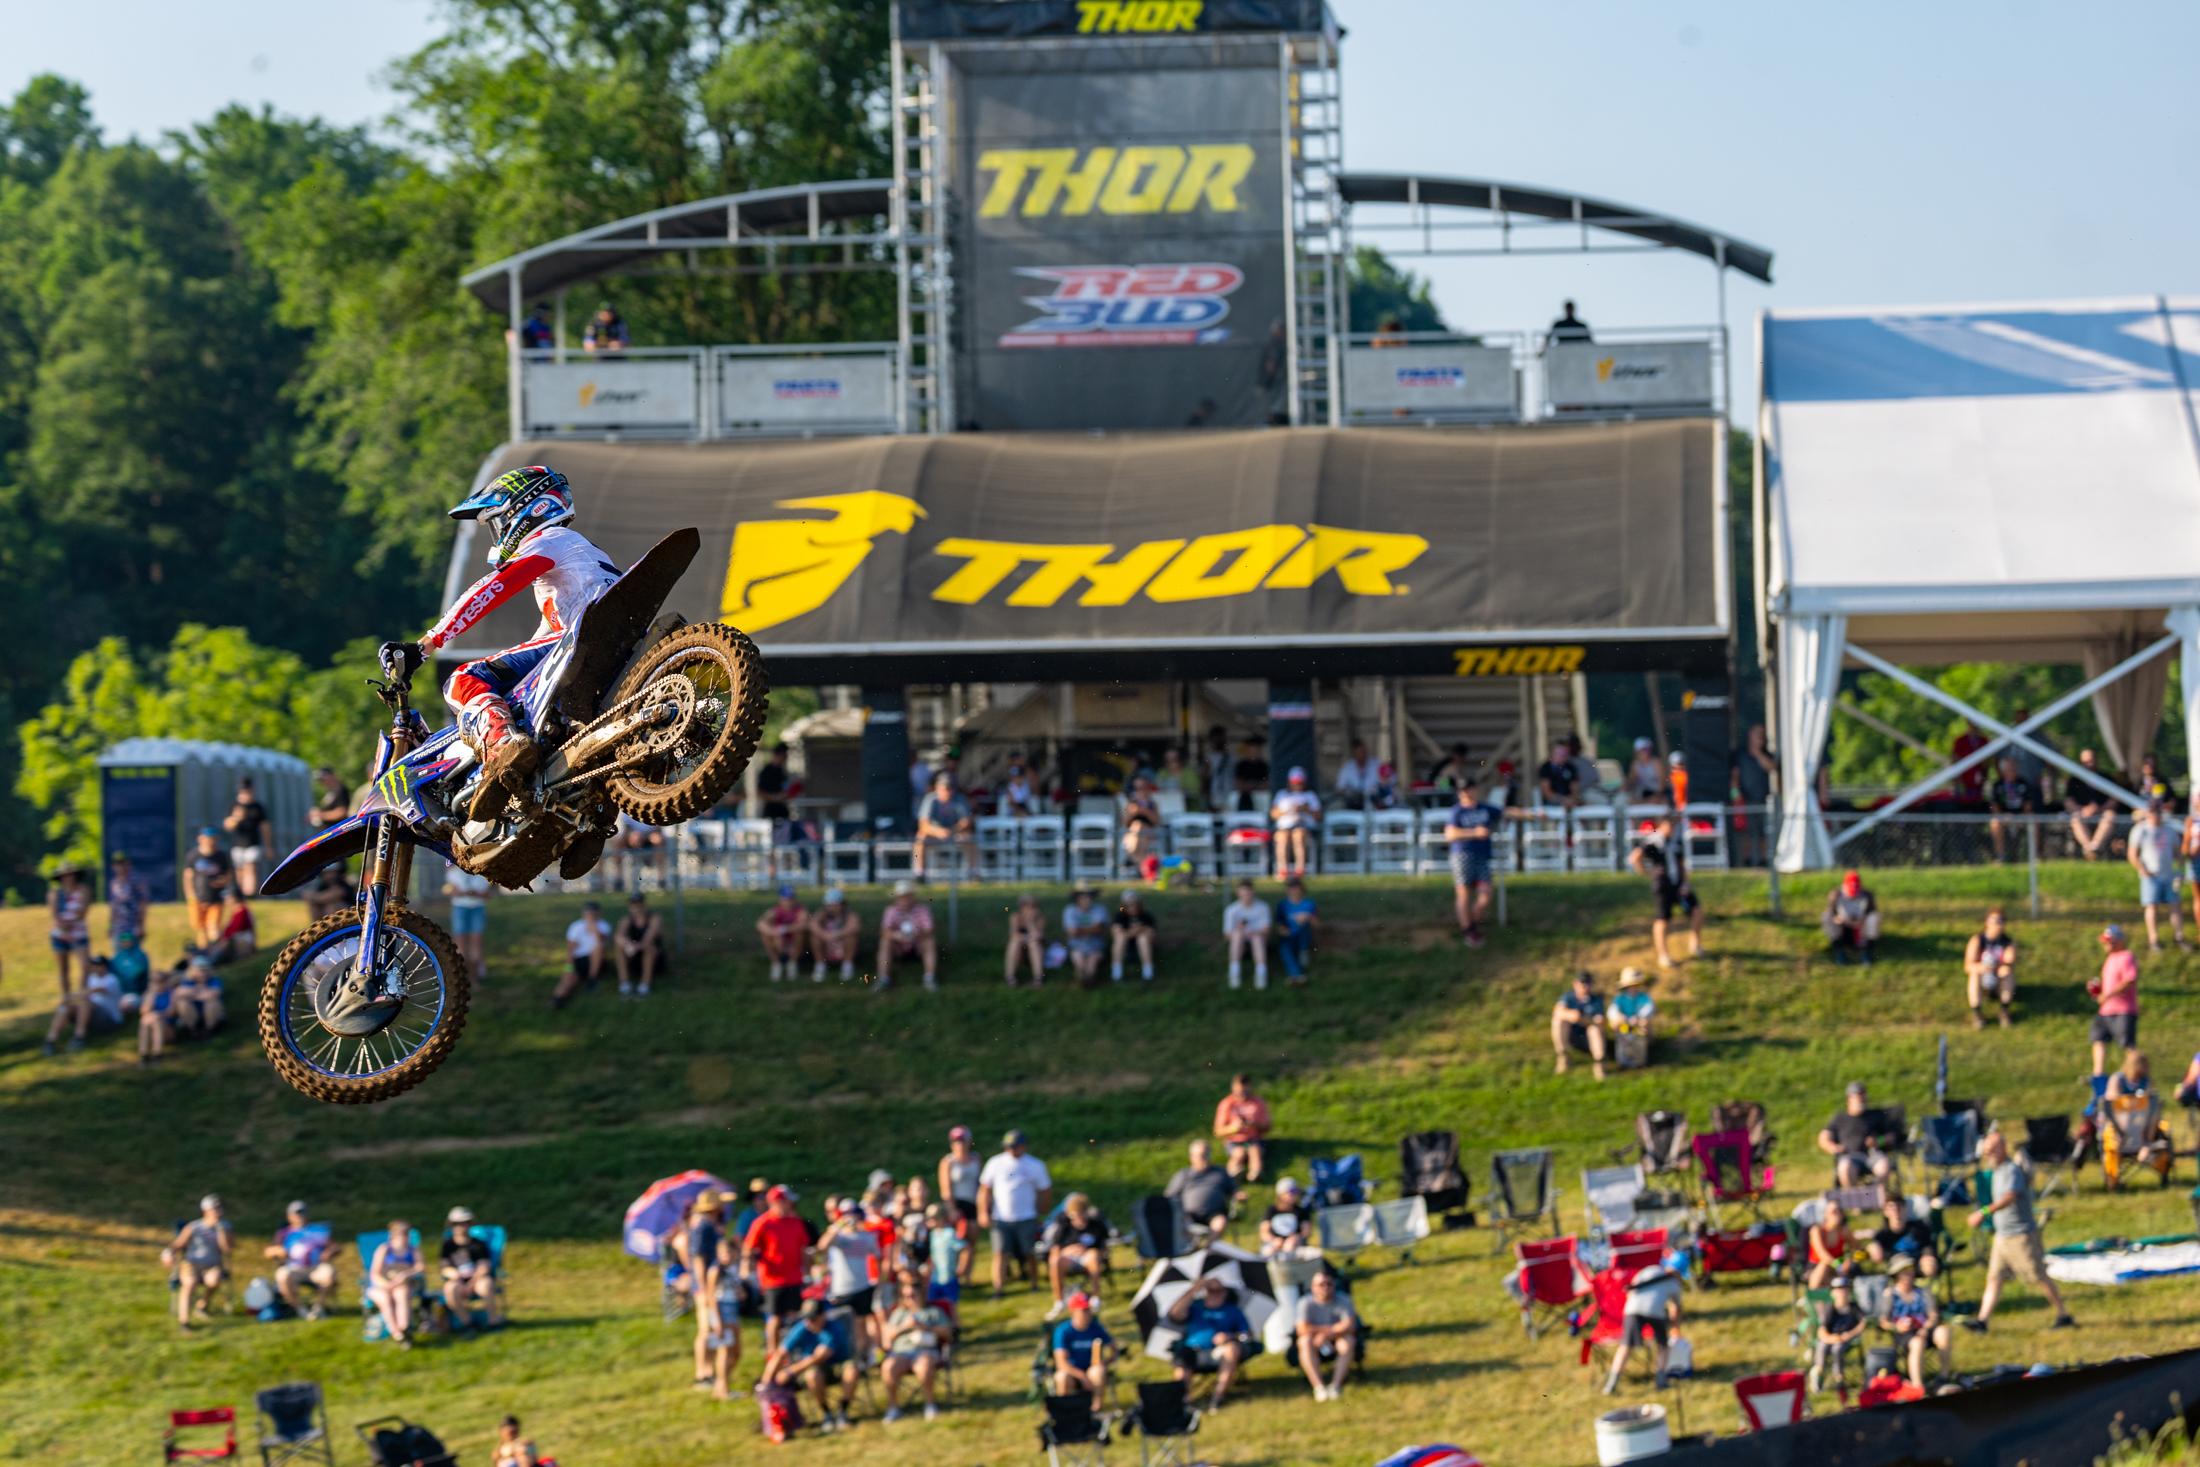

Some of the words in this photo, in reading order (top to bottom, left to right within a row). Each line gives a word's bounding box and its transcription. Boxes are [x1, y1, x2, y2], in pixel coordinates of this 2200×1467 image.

[1075, 0, 1204, 34] THOR
[977, 143, 1256, 218] THOR
[1010, 262, 1245, 300] RED
[506, 479, 552, 518] OAKLEY
[533, 501, 549, 514] BELL
[503, 519, 531, 550] MONSTER
[931, 523, 1429, 607] THOR
[1453, 645, 1586, 677] THOR
